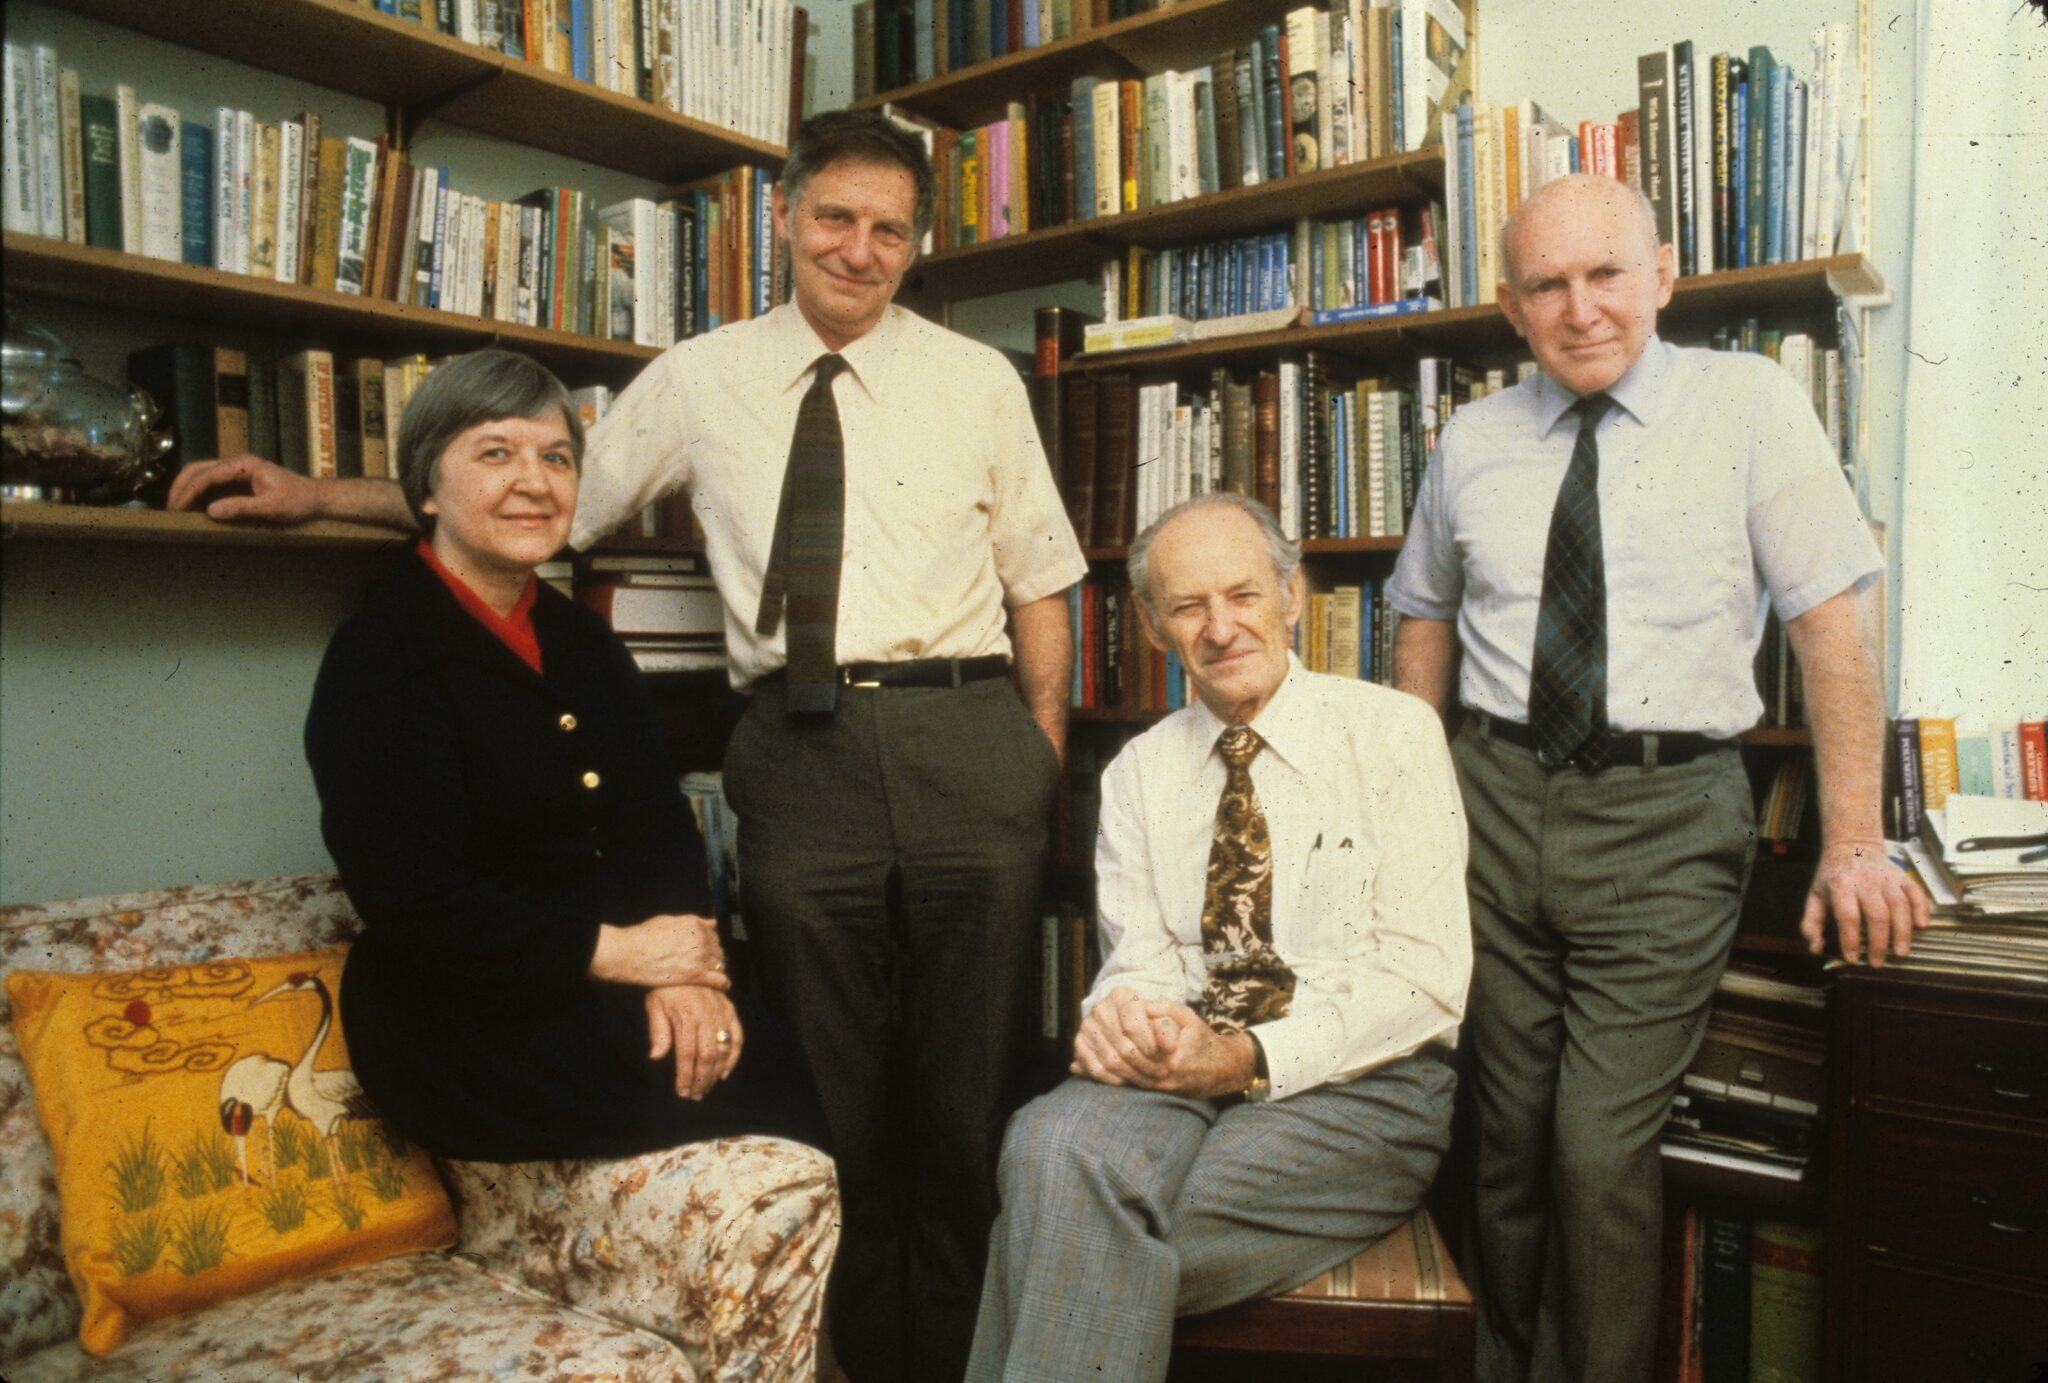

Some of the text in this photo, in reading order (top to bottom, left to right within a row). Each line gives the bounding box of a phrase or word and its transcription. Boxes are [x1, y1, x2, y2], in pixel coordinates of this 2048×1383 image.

[1647, 96, 1659, 120] With
[1679, 64, 1693, 214] SCIENTIFIC INSTRUMENTS
[286, 172, 296, 200] Other
[1650, 176, 1661, 201] Hand
[761, 183, 772, 272] WILDERNESS
[1401, 432, 1413, 508] WINTER BOTANY
[1108, 644, 1117, 668] Book
[2001, 731, 2015, 779] Interfacial
[2025, 741, 2038, 792] POLYMER
[1902, 738, 1916, 833] POLYMER SCIENCE
